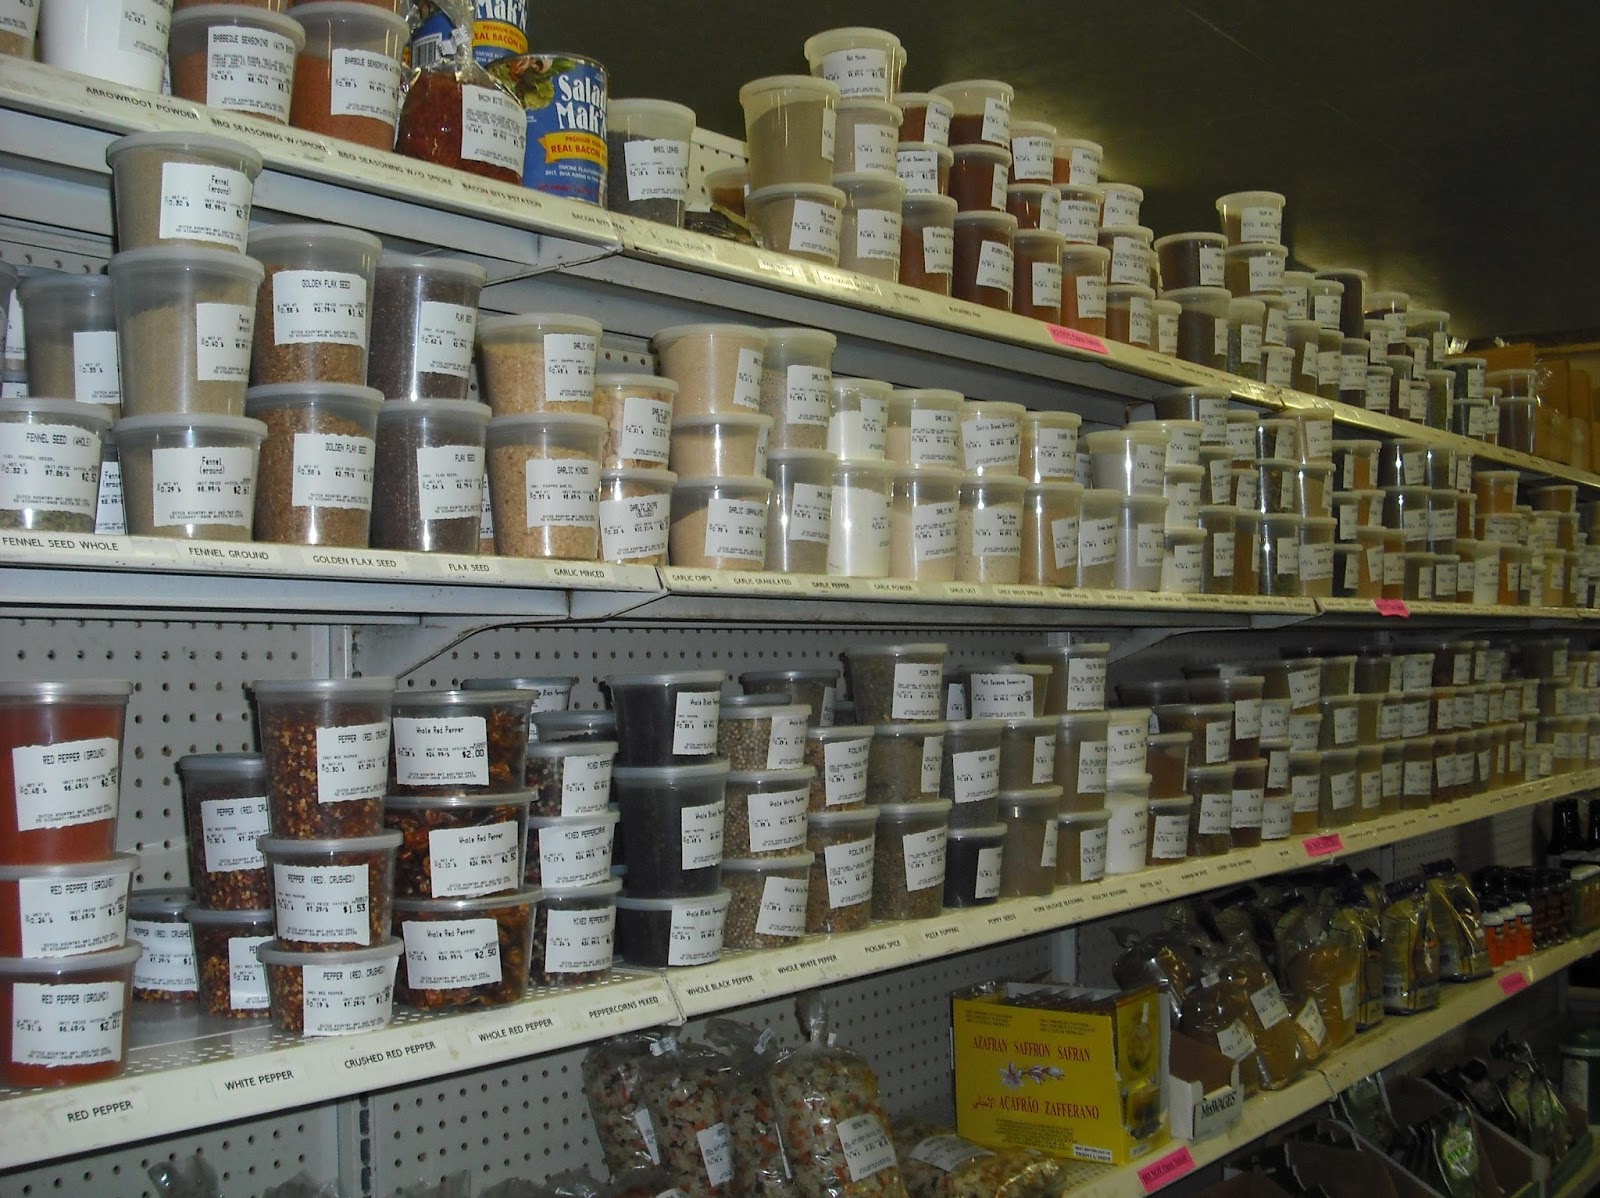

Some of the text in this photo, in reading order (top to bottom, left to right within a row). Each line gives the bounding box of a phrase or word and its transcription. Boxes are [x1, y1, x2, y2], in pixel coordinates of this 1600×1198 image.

[493, 33, 519, 46] BACON
[86, 86, 199, 120] ARROWROOT POWDER
[211, 118, 230, 128] BBQ
[233, 123, 283, 141] SEASONING
[551, 145, 600, 158] REAL BACON
[337, 150, 356, 161] BBQ
[357, 154, 404, 174] SEASONING
[427, 172, 453, 186] SMOKE
[462, 182, 489, 196] BACON
[302, 279, 321, 289] GOLDEN
[324, 279, 338, 289] FLAX
[27, 432, 49, 443] FENNEL
[53, 434, 67, 444] SEED
[325, 443, 344, 452] GOLDEN
[202, 456, 221, 465] Fennel
[2, 537, 119, 551] FENNEL SEED WHOLE
[189, 547, 269, 560] FENNEL GROUND
[313, 555, 397, 568] GOLDEN FLAX SEED
[449, 563, 490, 572] FLAX SEED
[554, 568, 605, 578] GARLIC MINCED
[672, 574, 694, 582] GARLIC
[733, 578, 792, 586] GARLIC GRANULATED
[416, 726, 464, 734] Whole Red Pepper
[338, 734, 357, 744] PEPPER
[43, 755, 54, 765] RED
[58, 752, 80, 763] PEPPER
[462, 749, 484, 758] $2.00
[216, 807, 235, 816] PEPPER
[459, 835, 475, 844] Whole
[477, 835, 487, 843] Red
[564, 831, 580, 840] MIXED
[288, 874, 304, 884] PEPPER
[50, 885, 62, 895] RED
[65, 883, 88, 894] PEPPER
[344, 904, 365, 913] $1.53
[988, 916, 1003, 925] POPPY
[134, 928, 150, 936] PEPPER
[427, 928, 475, 938] Whole Red Pepper
[925, 926, 959, 940] PIZZA TOPPING
[864, 940, 901, 954] PICKLING SPICE
[475, 948, 496, 959] $2.50
[777, 955, 838, 974] WHOLE WHITE PEPPER
[323, 972, 343, 980] PEPPER
[686, 975, 754, 995] WHOLE BLACK PEPPER
[41, 994, 53, 1004] RED
[57, 994, 79, 1004] PEPPER
[588, 996, 659, 1019] PEPPERCORNS MIXED
[478, 1018, 554, 1042] WHOLE RED PEPPER
[344, 1041, 436, 1069] CRUSHED RED PEPPER
[974, 1037, 1091, 1062] AZAFRAN SAFFRON SAFRAN
[225, 1070, 294, 1091] WHITE PEPPER
[67, 1100, 134, 1123] RED PEPPER
[1000, 1095, 1039, 1113] AÇAFRÃO
[1045, 1101, 1100, 1120] ZAFFERANO
